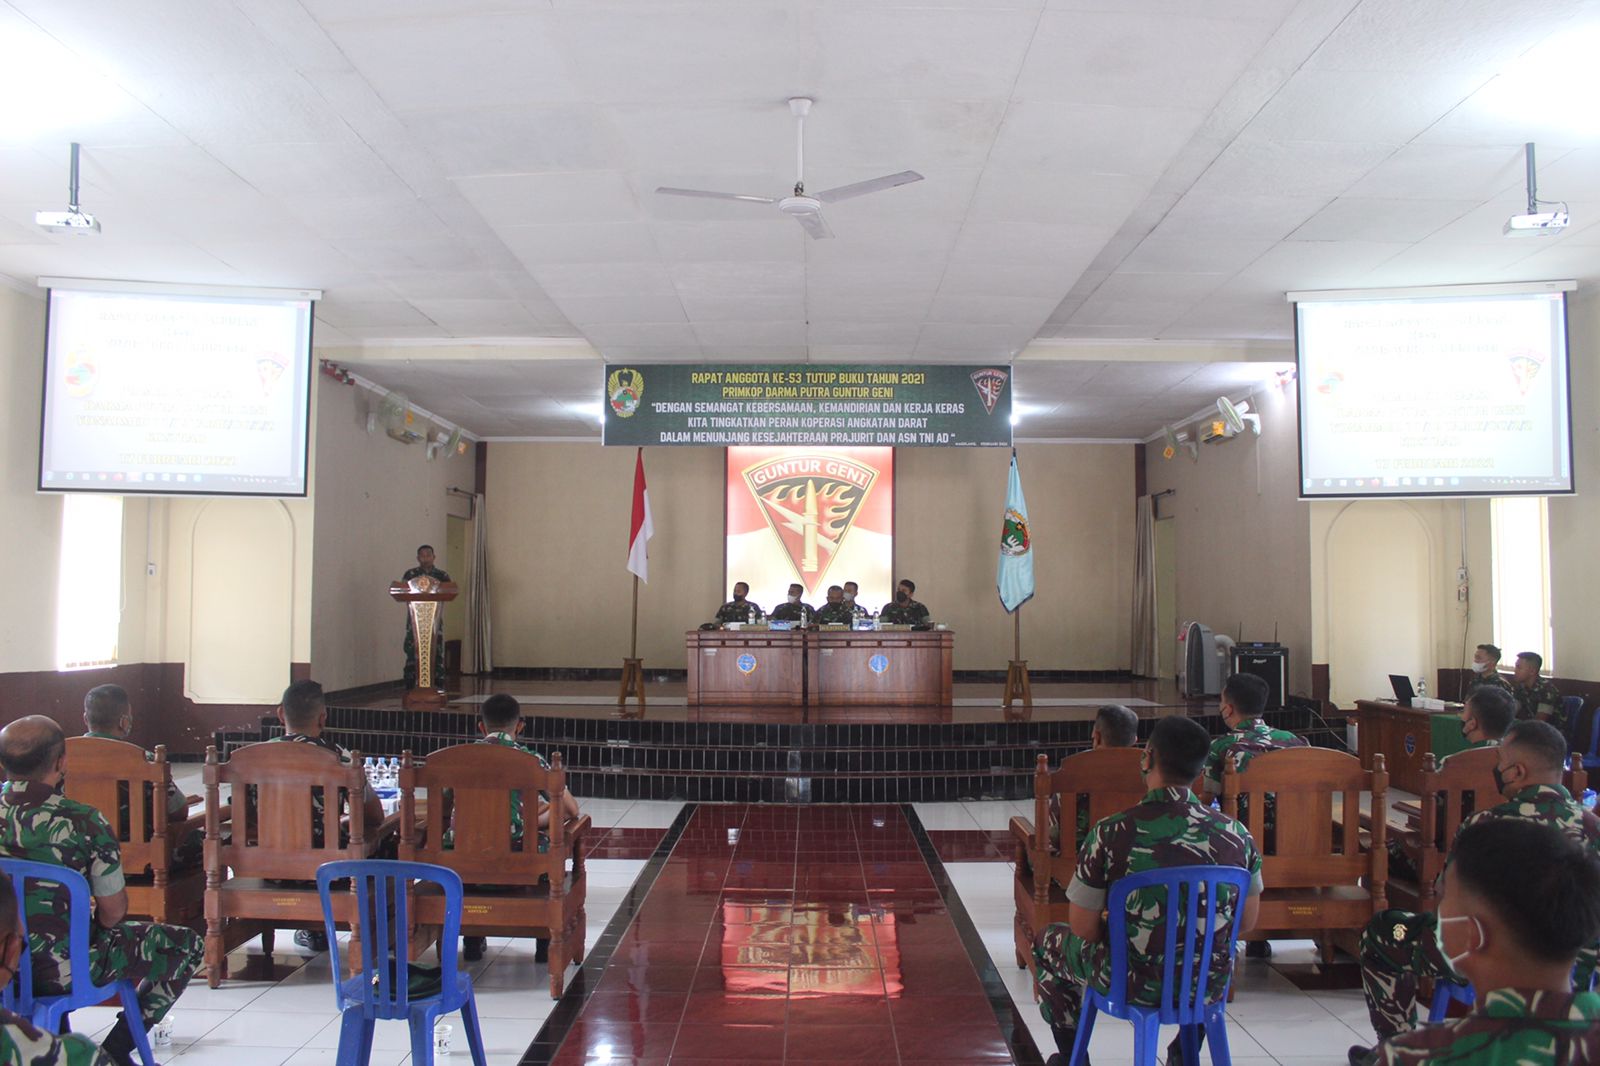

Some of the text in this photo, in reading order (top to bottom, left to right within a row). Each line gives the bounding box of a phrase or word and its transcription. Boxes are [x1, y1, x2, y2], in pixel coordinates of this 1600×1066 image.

[691, 372, 723, 384] RAPAT
[725, 372, 770, 384] ANGGOTA
[806, 372, 836, 384] TUTUP
[839, 372, 864, 384] BUKU
[867, 372, 899, 384] TAHUN
[901, 372, 925, 384] 2021
[722, 386, 894, 398] PRIMKOP DARMA PUTRA GUNTUR GENI
[695, 402, 744, 413] SEMANGAT
[746, 402, 817, 413] KEBERSAMAAN,
[819, 402, 881, 413] KEMANDIRIAN
[883, 402, 902, 413] DAN
[904, 402, 934, 413] KERJA
[936, 402, 965, 413] KERAS
[688, 417, 928, 428] KITA TINGKATKAN PERAN KOPERASI ANGKATAN DARAT
[660, 432, 691, 443] DALAM
[693, 432, 751, 443] MENUNJANG
[752, 432, 828, 443] KESEJAHTERAAN
[830, 432, 875, 443] PRAJURIT
[877, 432, 896, 443] DAN
[898, 432, 917, 443] ASN
[919, 432, 935, 443] TNI
[753, 460, 868, 486] GUNTUR GENI
